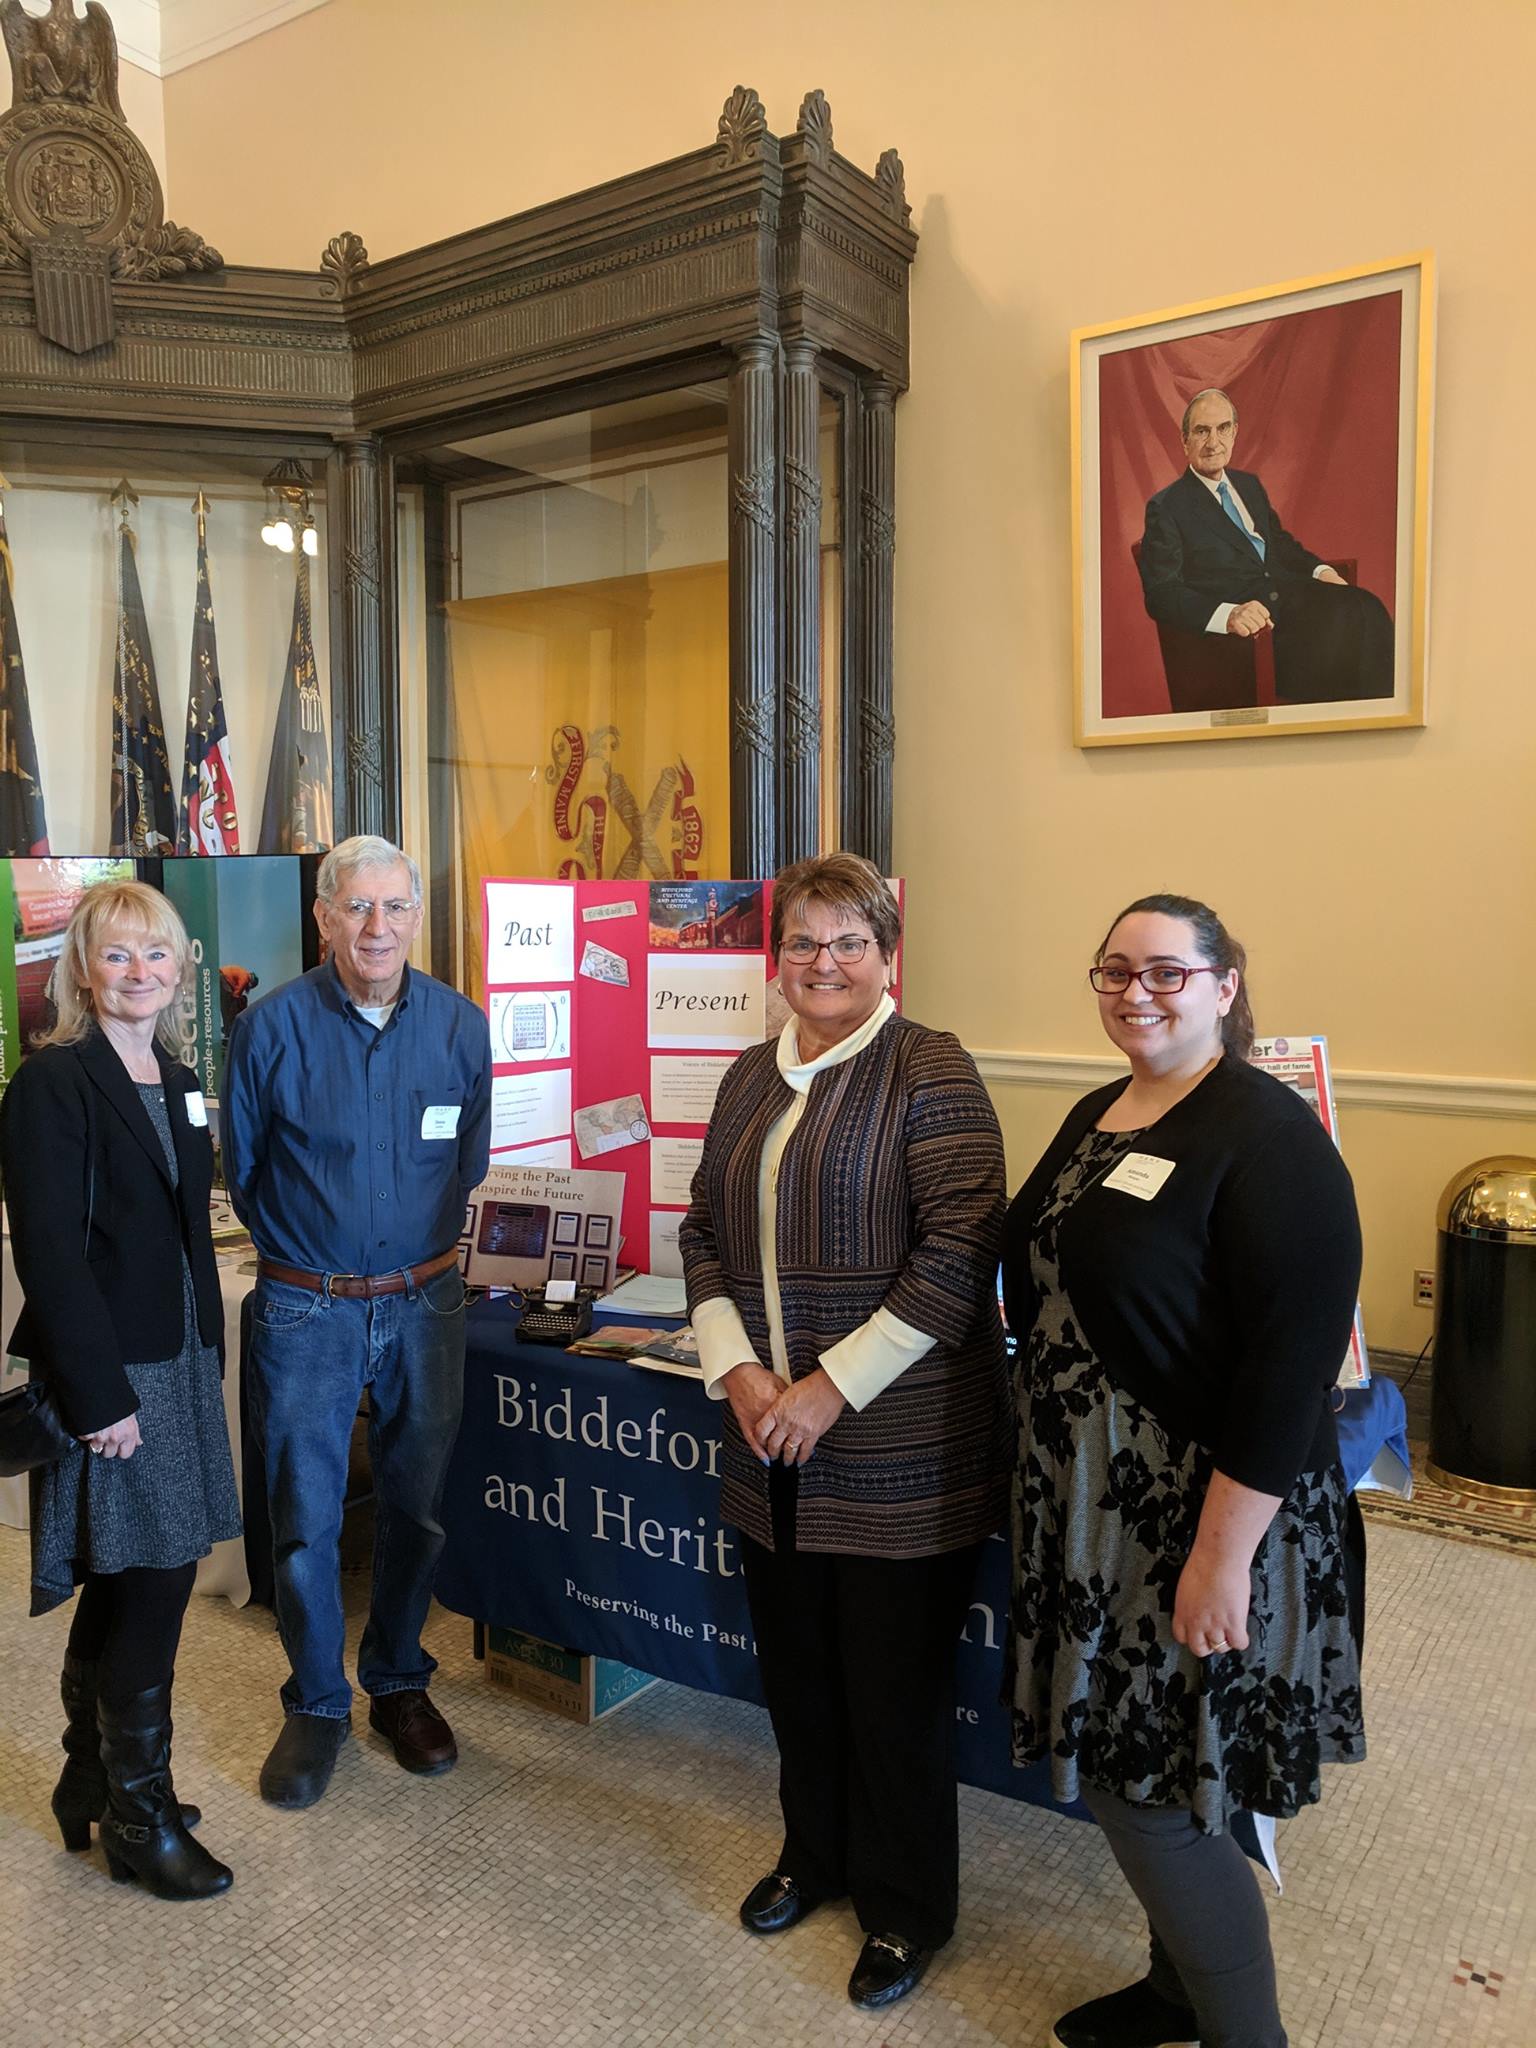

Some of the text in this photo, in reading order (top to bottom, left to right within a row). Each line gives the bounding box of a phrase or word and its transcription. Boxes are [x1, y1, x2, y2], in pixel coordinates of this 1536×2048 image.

[555, 740, 584, 834] FIRST MAINE
[684, 812, 700, 854] 1862
[504, 921, 553, 946] Past
[655, 990, 750, 1012] Present
[203, 967, 217, 1097] people+resources
[521, 1186, 541, 1198] the
[544, 1187, 584, 1201] Future
[523, 1170, 542, 1182] the
[546, 1172, 571, 1184] Past
[484, 1474, 745, 1577] and Herit
[565, 1578, 660, 1630] Preserving
[664, 1614, 694, 1639] the
[701, 1623, 747, 1650] Past
